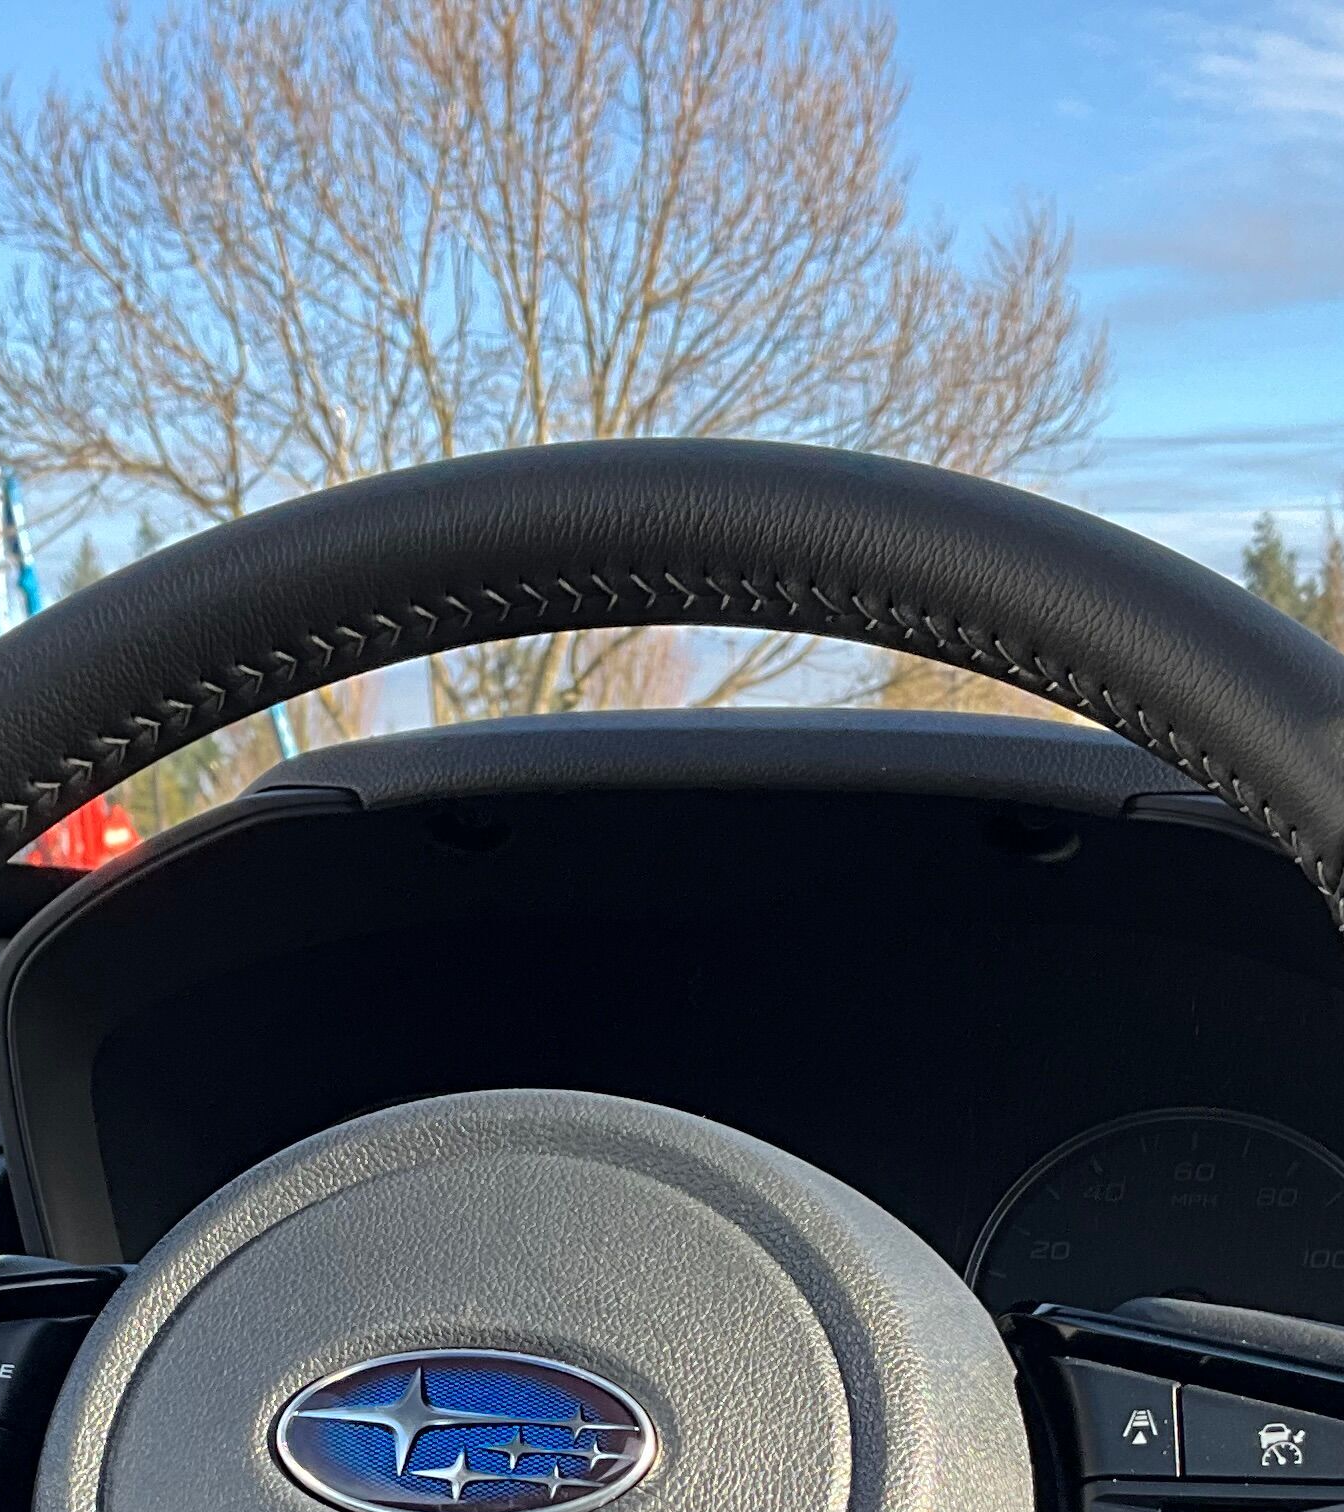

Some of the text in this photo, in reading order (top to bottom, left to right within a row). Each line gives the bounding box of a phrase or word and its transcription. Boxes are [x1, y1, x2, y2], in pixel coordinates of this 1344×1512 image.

[1173, 1162, 1215, 1182] 60
[1171, 1192, 1218, 1208] MPH
[1257, 1187, 1298, 1208] 80
[1030, 1240, 1070, 1260] 20
